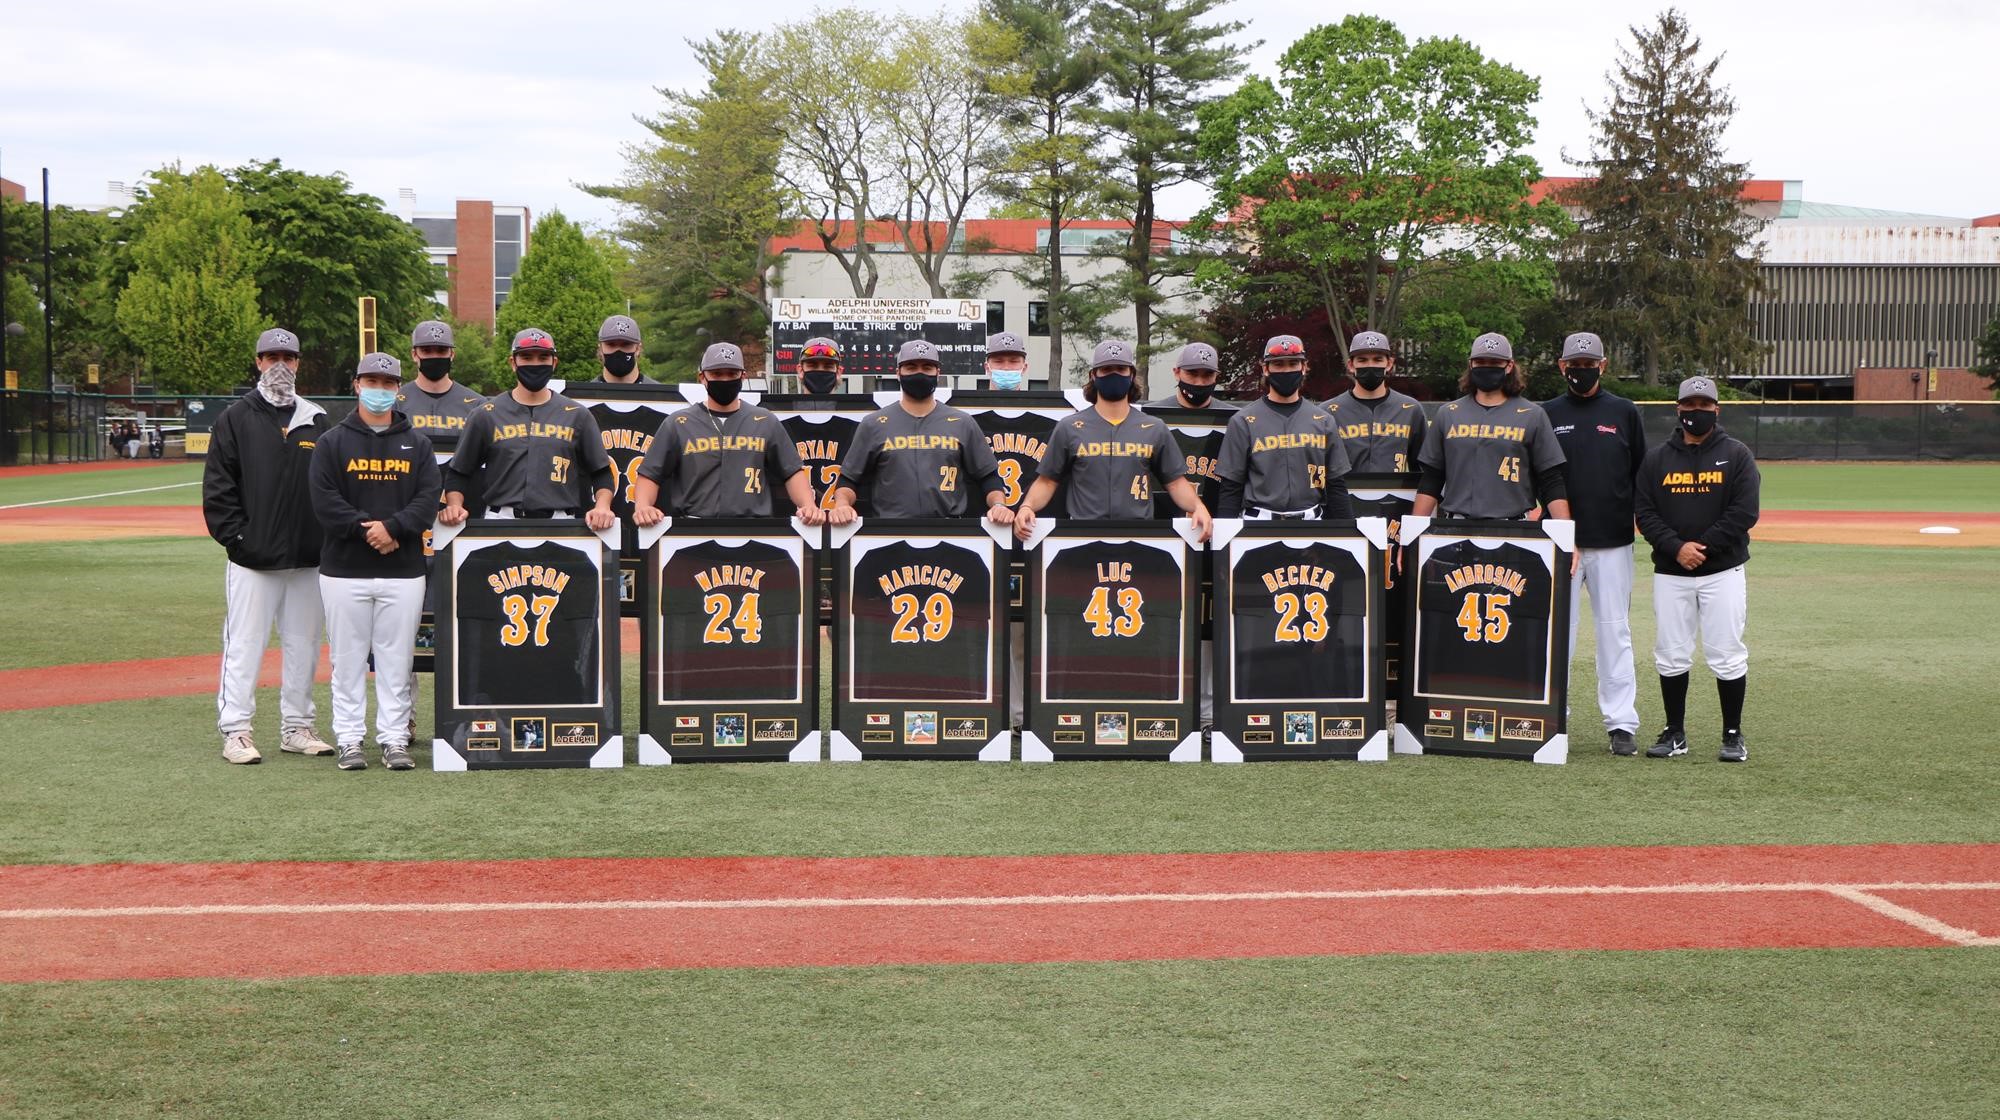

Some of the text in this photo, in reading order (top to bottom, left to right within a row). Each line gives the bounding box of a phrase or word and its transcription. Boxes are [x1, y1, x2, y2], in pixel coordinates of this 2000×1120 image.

[903, 323, 923, 331] OUT
[957, 323, 972, 331] H/E
[411, 415, 468, 430] DELPH
[493, 422, 574, 443] ADELPHI
[1338, 422, 1411, 439] ADELPHI
[1446, 423, 1526, 442] ADELPHI
[683, 436, 766, 455] ADELPHI
[796, 439, 839, 460] RYAN
[882, 435, 960, 452] ADELPHI
[1075, 441, 1154, 458] ADELPHI
[1251, 434, 1326, 453] ADELPHI
[346, 458, 410, 474] ADELPHI
[551, 456, 570, 485] 37
[1498, 456, 1521, 483] 45
[744, 467, 762, 494] 24
[939, 466, 957, 492] 29
[1130, 475, 1148, 500] 43
[1662, 471, 1723, 486] ADELPHI
[487, 564, 571, 594] SIMPSON
[694, 565, 766, 593] WARICK
[878, 564, 964, 597] MARICICH
[1096, 561, 1132, 583] LUC
[1261, 564, 1335, 593] BECKER
[501, 593, 560, 647] 37
[703, 592, 762, 644] 24
[891, 592, 954, 644] 29
[1082, 586, 1144, 638] 43
[1274, 592, 1330, 643] 23
[1456, 592, 1512, 644] 45
[555, 735, 597, 744] ADELPHI
[755, 730, 795, 739] ADELPHI
[945, 729, 985, 738] ADELPHI
[1136, 729, 1176, 738] ADELPHI
[1324, 728, 1362, 737] ADELPHI
[1504, 727, 1542, 738] ADELPHI
